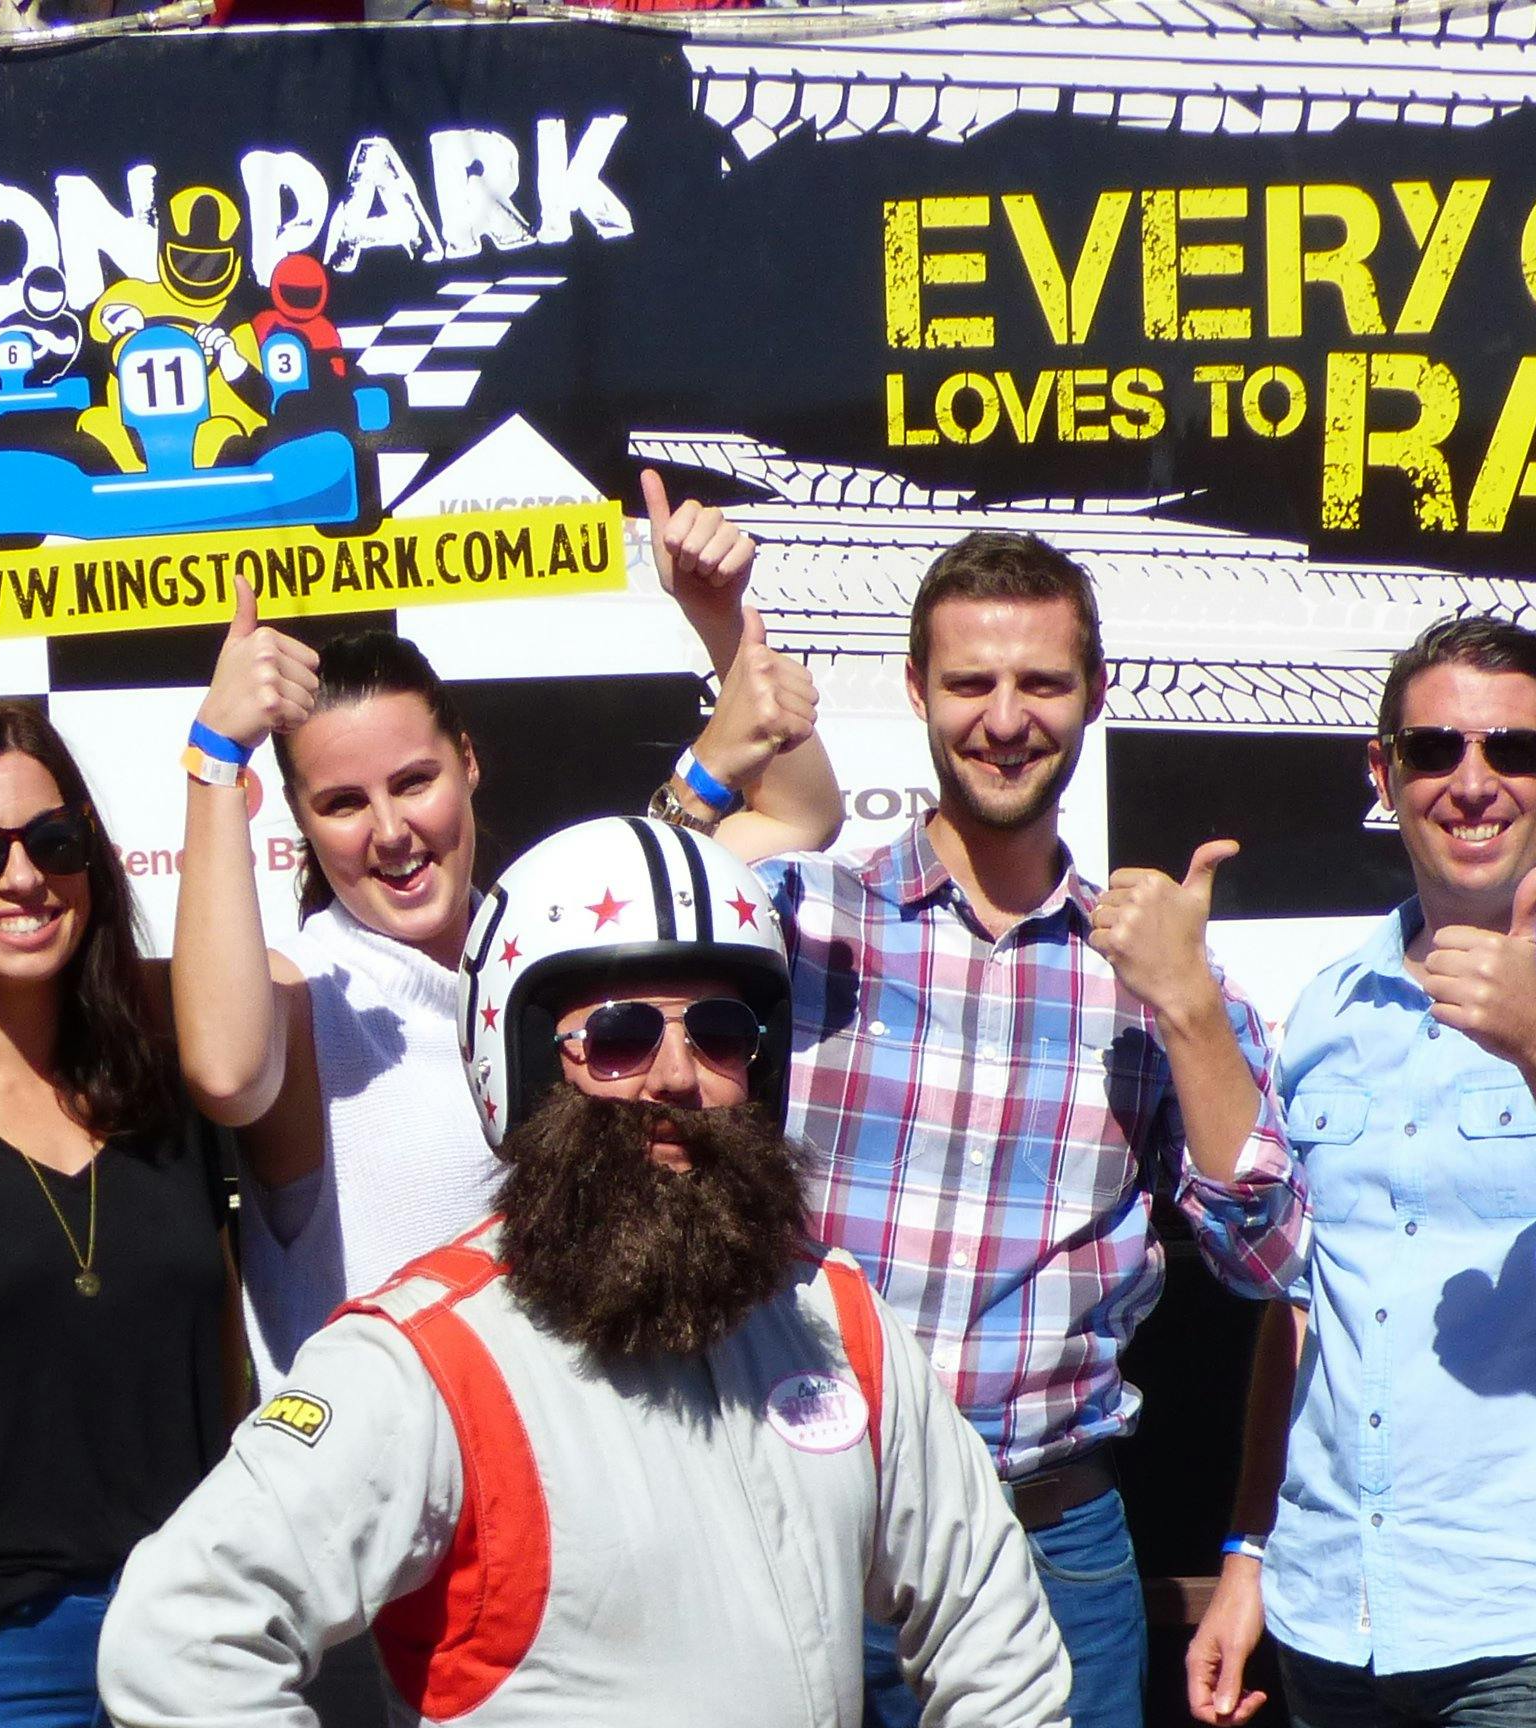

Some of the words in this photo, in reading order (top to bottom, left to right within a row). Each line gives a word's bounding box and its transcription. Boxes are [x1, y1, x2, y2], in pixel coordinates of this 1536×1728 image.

[240, 114, 633, 286] PARK
[884, 179, 1491, 349] EVERY
[8, 344, 18, 365] 6
[137, 356, 187, 408] 11
[277, 353, 292, 374] 3
[886, 368, 1166, 447] LOVES
[1193, 363, 1308, 440] TO
